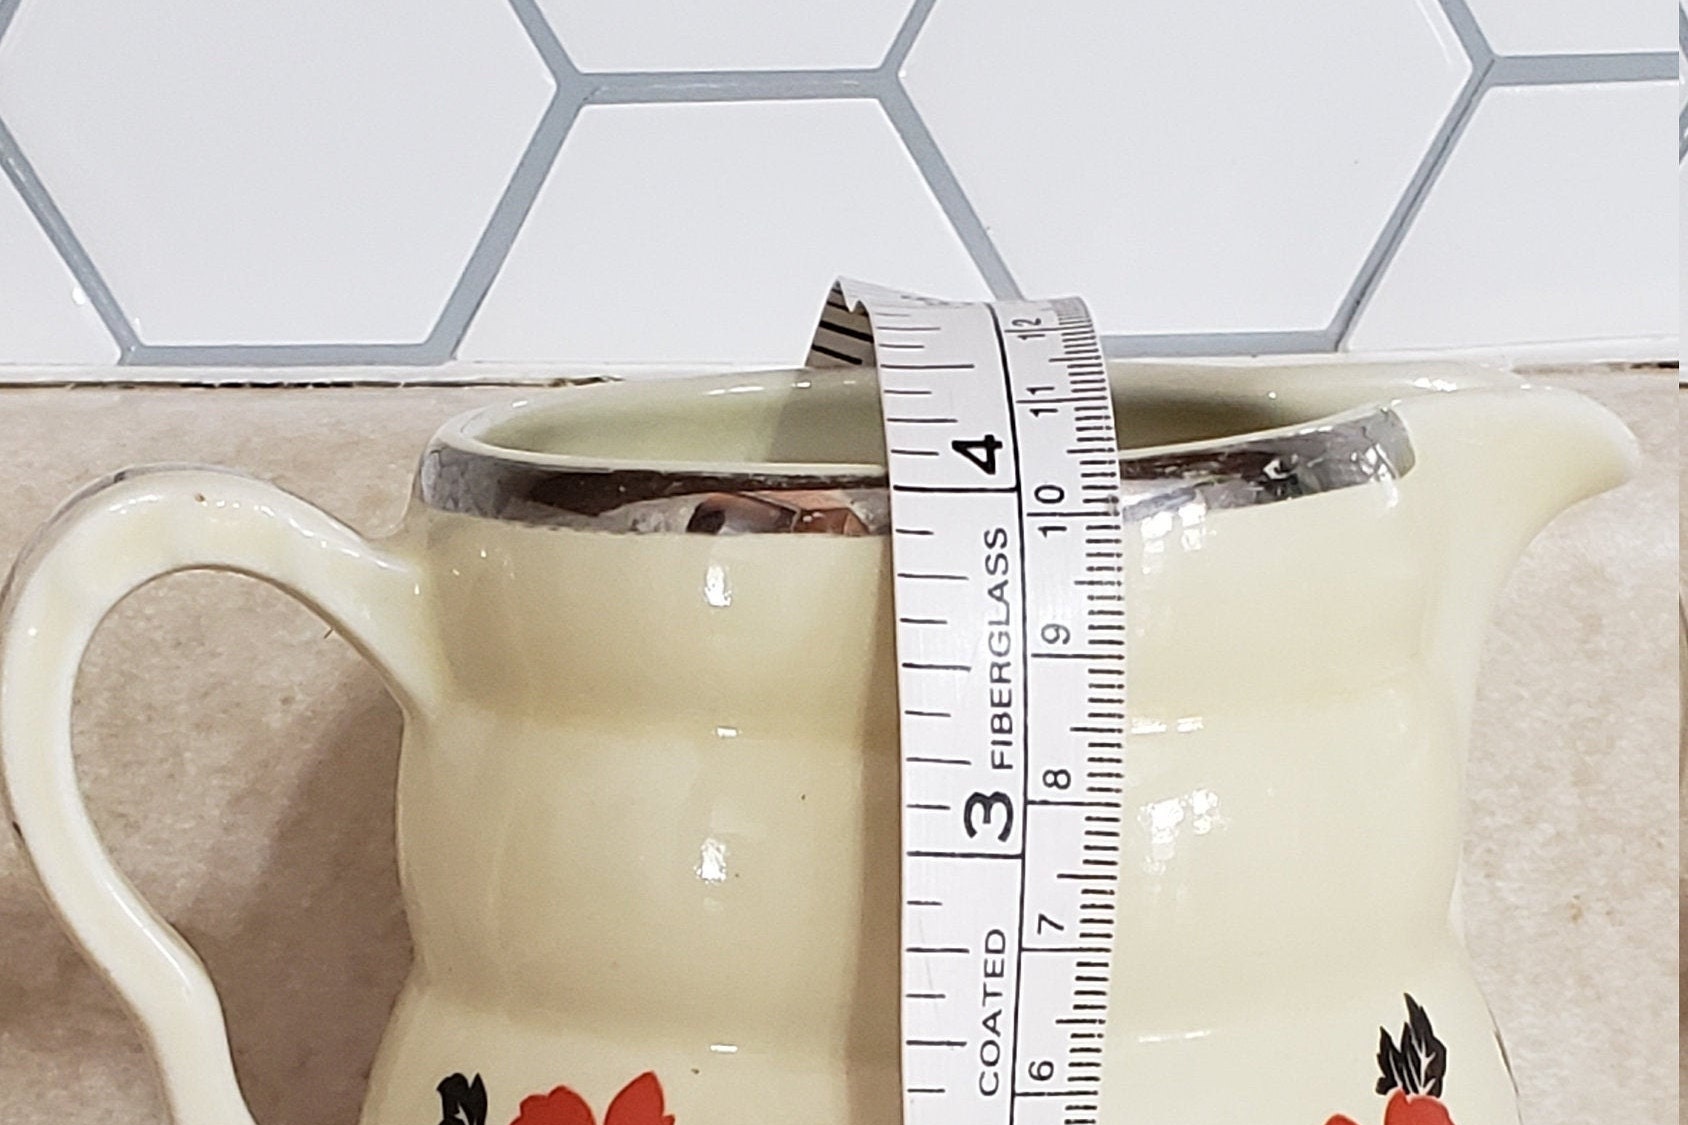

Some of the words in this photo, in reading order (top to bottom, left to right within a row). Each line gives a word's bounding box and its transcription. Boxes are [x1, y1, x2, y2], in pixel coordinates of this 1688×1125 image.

[1012, 317, 1046, 341] 12
[1025, 385, 1059, 418] 11
[951, 433, 1003, 475] 4
[1033, 483, 1068, 539] 10
[983, 526, 1014, 770] FIBERGLASS
[1040, 622, 1071, 645] 9
[1042, 768, 1071, 790] 8
[963, 790, 1014, 843] 3
[1036, 912, 1065, 936] 7
[978, 928, 1007, 1097] COATED
[1028, 1060, 1055, 1082] 6
